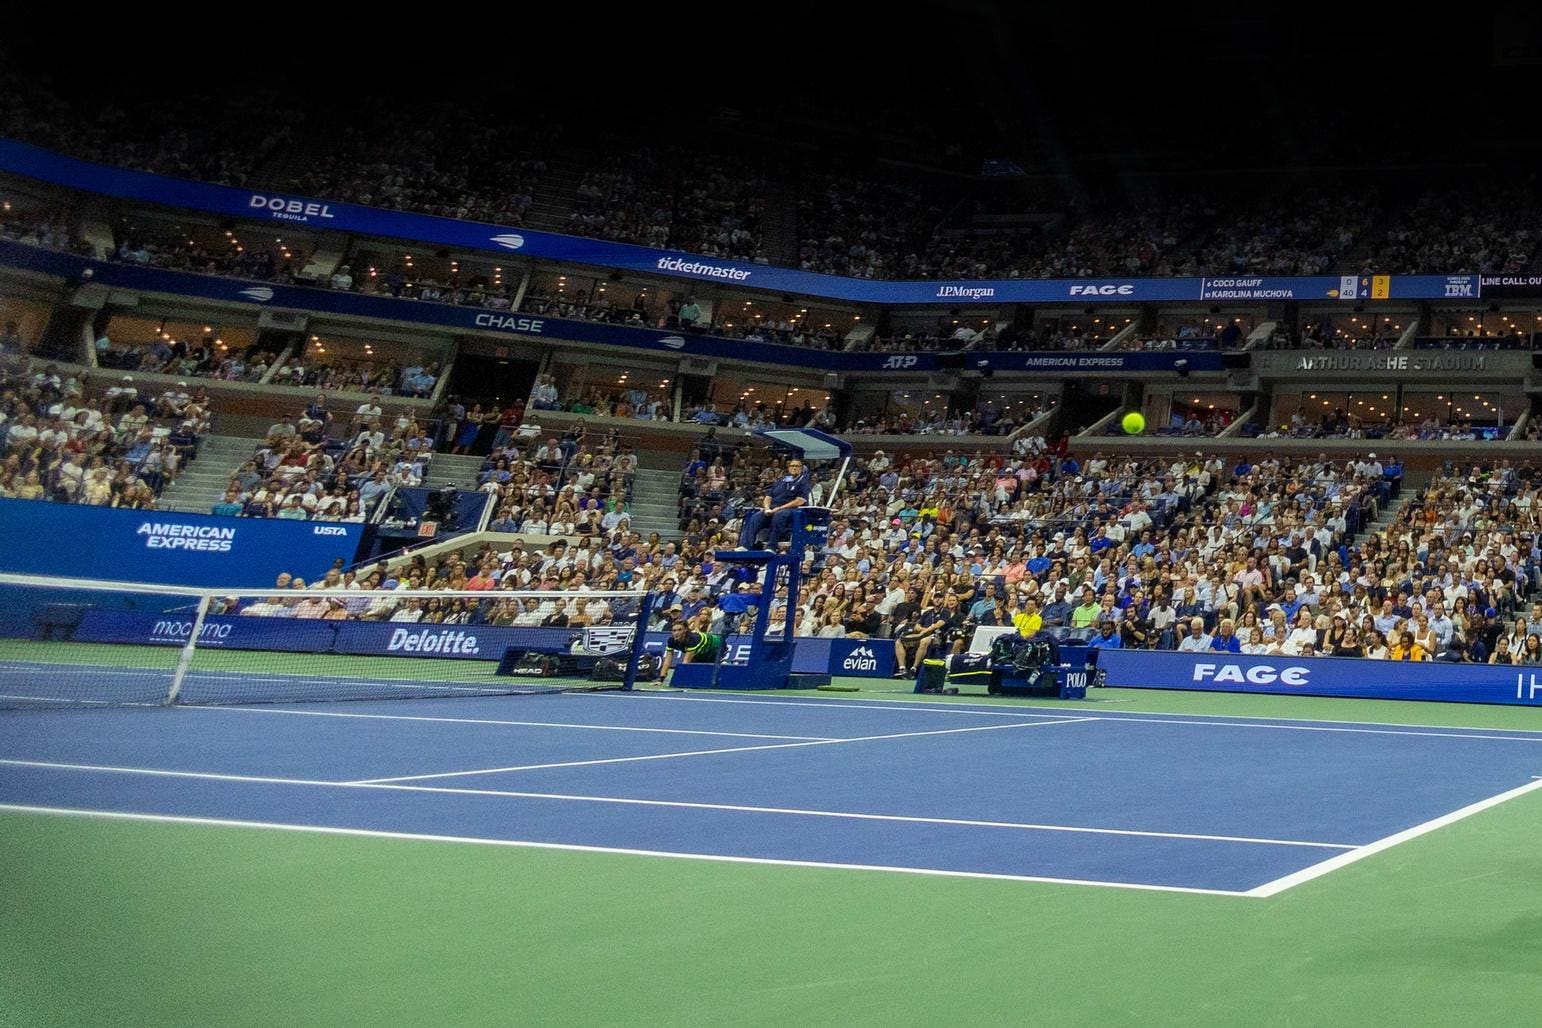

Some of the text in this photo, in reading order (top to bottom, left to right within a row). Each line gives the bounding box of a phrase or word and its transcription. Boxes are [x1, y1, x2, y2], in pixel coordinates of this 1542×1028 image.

[250, 195, 334, 218] DOBEL
[272, 212, 308, 221] TEQUILA
[657, 257, 751, 280] ticketmaster
[1212, 279, 1236, 288] COCO
[1236, 279, 1263, 288] GAUFF
[1361, 278, 1369, 287] 6
[1377, 278, 1384, 287] 3
[1481, 278, 1501, 286] LINE
[1502, 277, 1527, 286] CALL:
[936, 286, 994, 299] J.P.Morgan
[1070, 285, 1134, 295] FAGE
[1211, 290, 1252, 298] KAROLINA
[1253, 289, 1293, 298] MUCHOVA
[1342, 289, 1384, 297] 40 4 2
[1445, 284, 1472, 297] IBM
[475, 314, 544, 333] CHASE
[881, 355, 918, 369] ATP
[1025, 357, 1124, 366] AMERICAN EXPRESS
[1297, 356, 1485, 370] ARTHUR ASHE STADIUM
[137, 522, 235, 540] AMERICAN
[313, 526, 347, 536] USTA
[147, 536, 232, 552] EXPRESS
[843, 656, 877, 671] evian
[1066, 673, 1087, 688] POLO
[1193, 663, 1311, 686] FAGE
